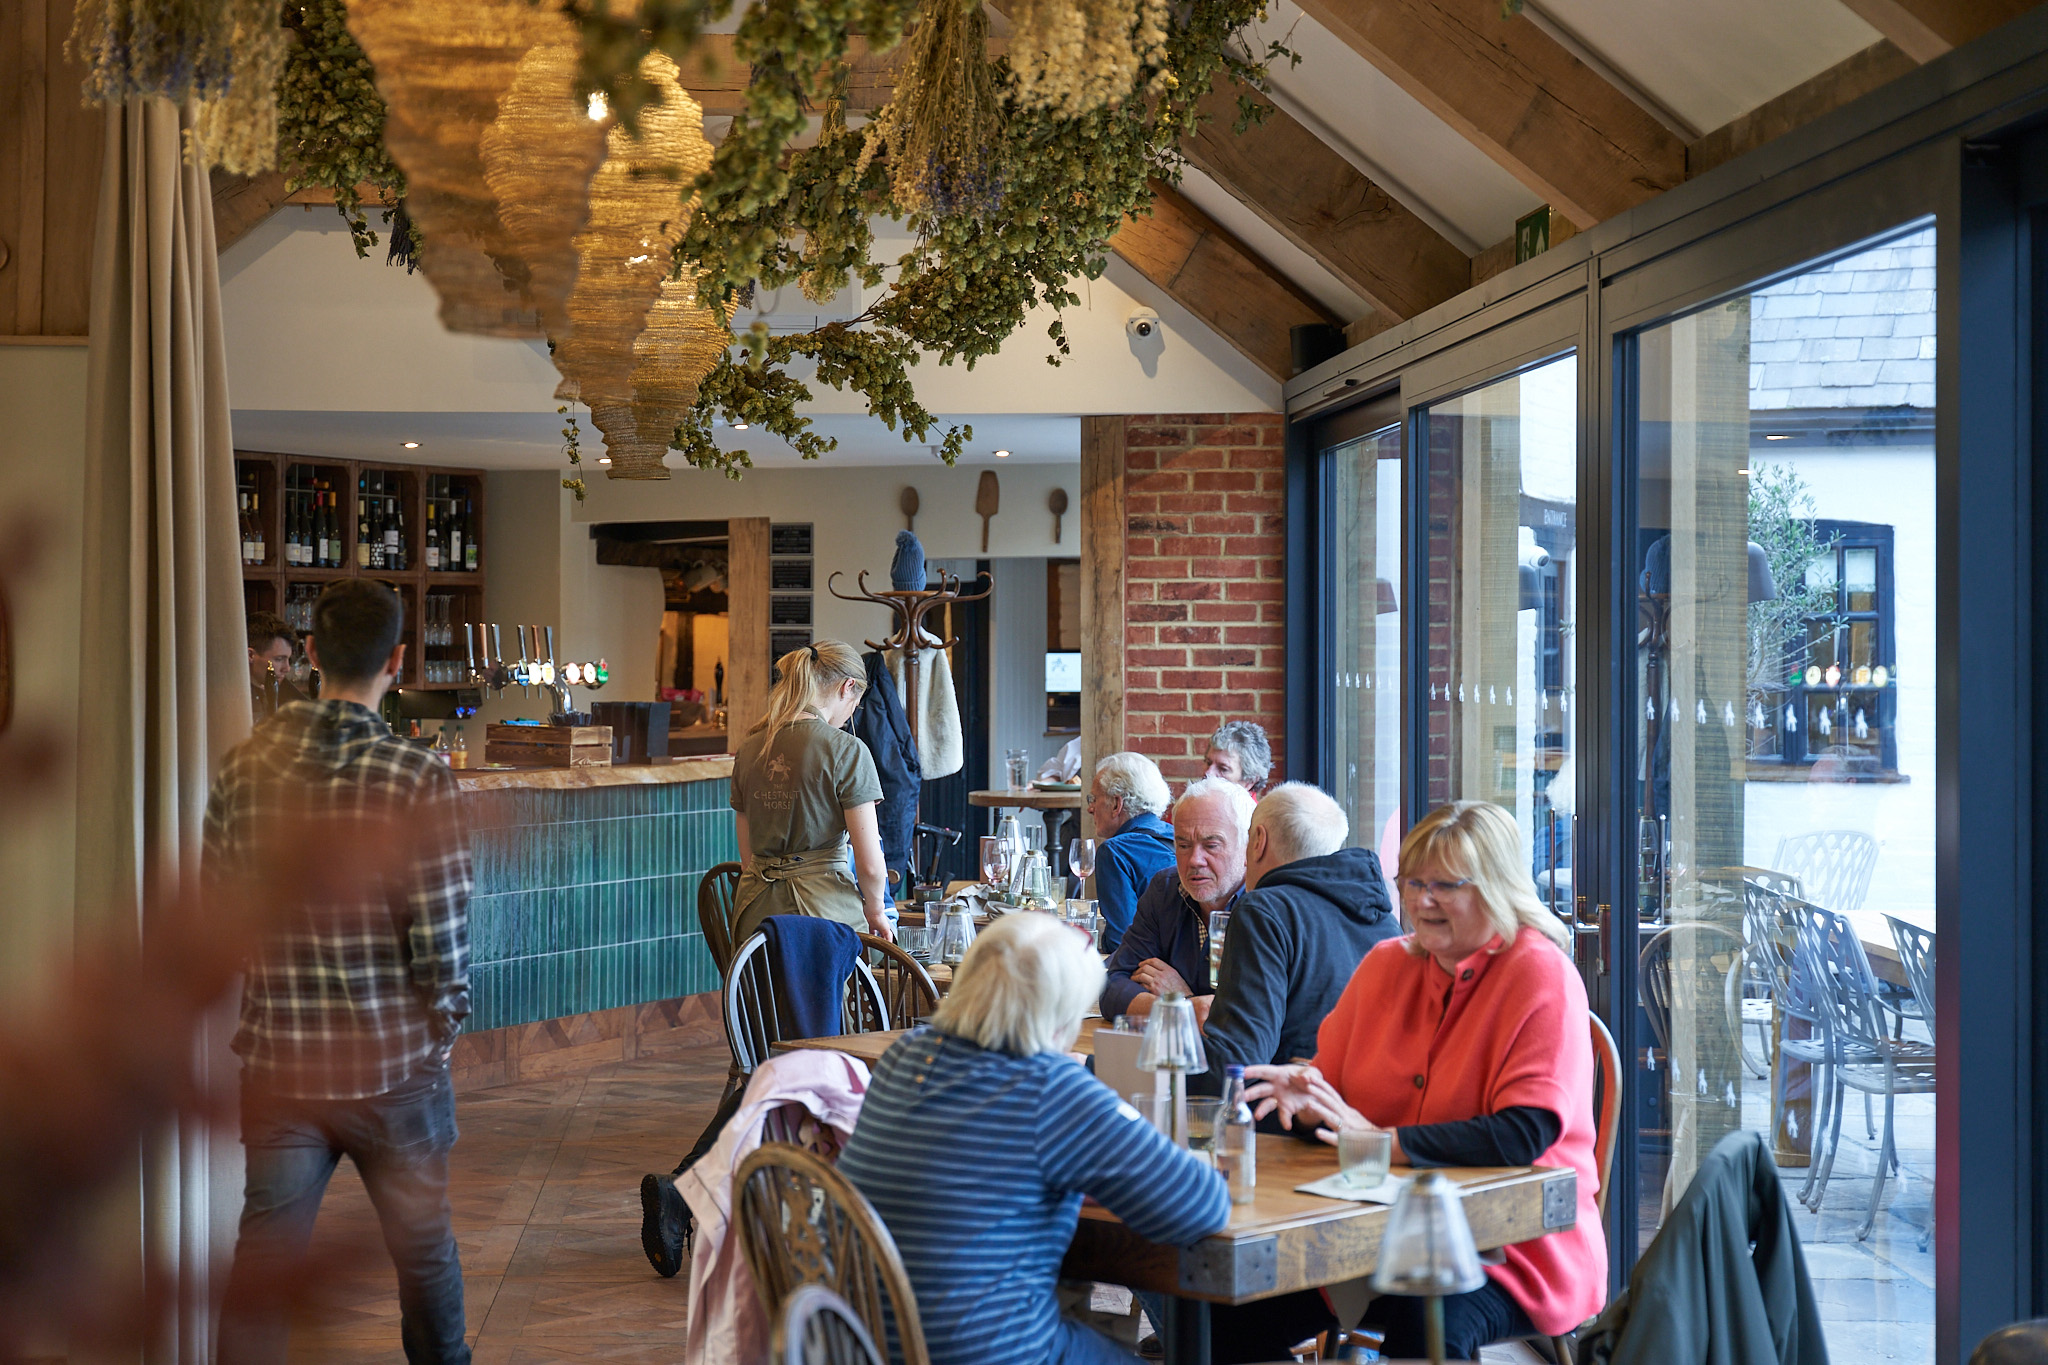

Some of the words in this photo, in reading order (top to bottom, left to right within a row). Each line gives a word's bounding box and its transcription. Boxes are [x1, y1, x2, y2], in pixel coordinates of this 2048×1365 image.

[1544, 508, 1567, 528] ENTRANCE
[754, 790, 800, 800] CHESTNUT
[764, 801, 791, 810] HORSE
